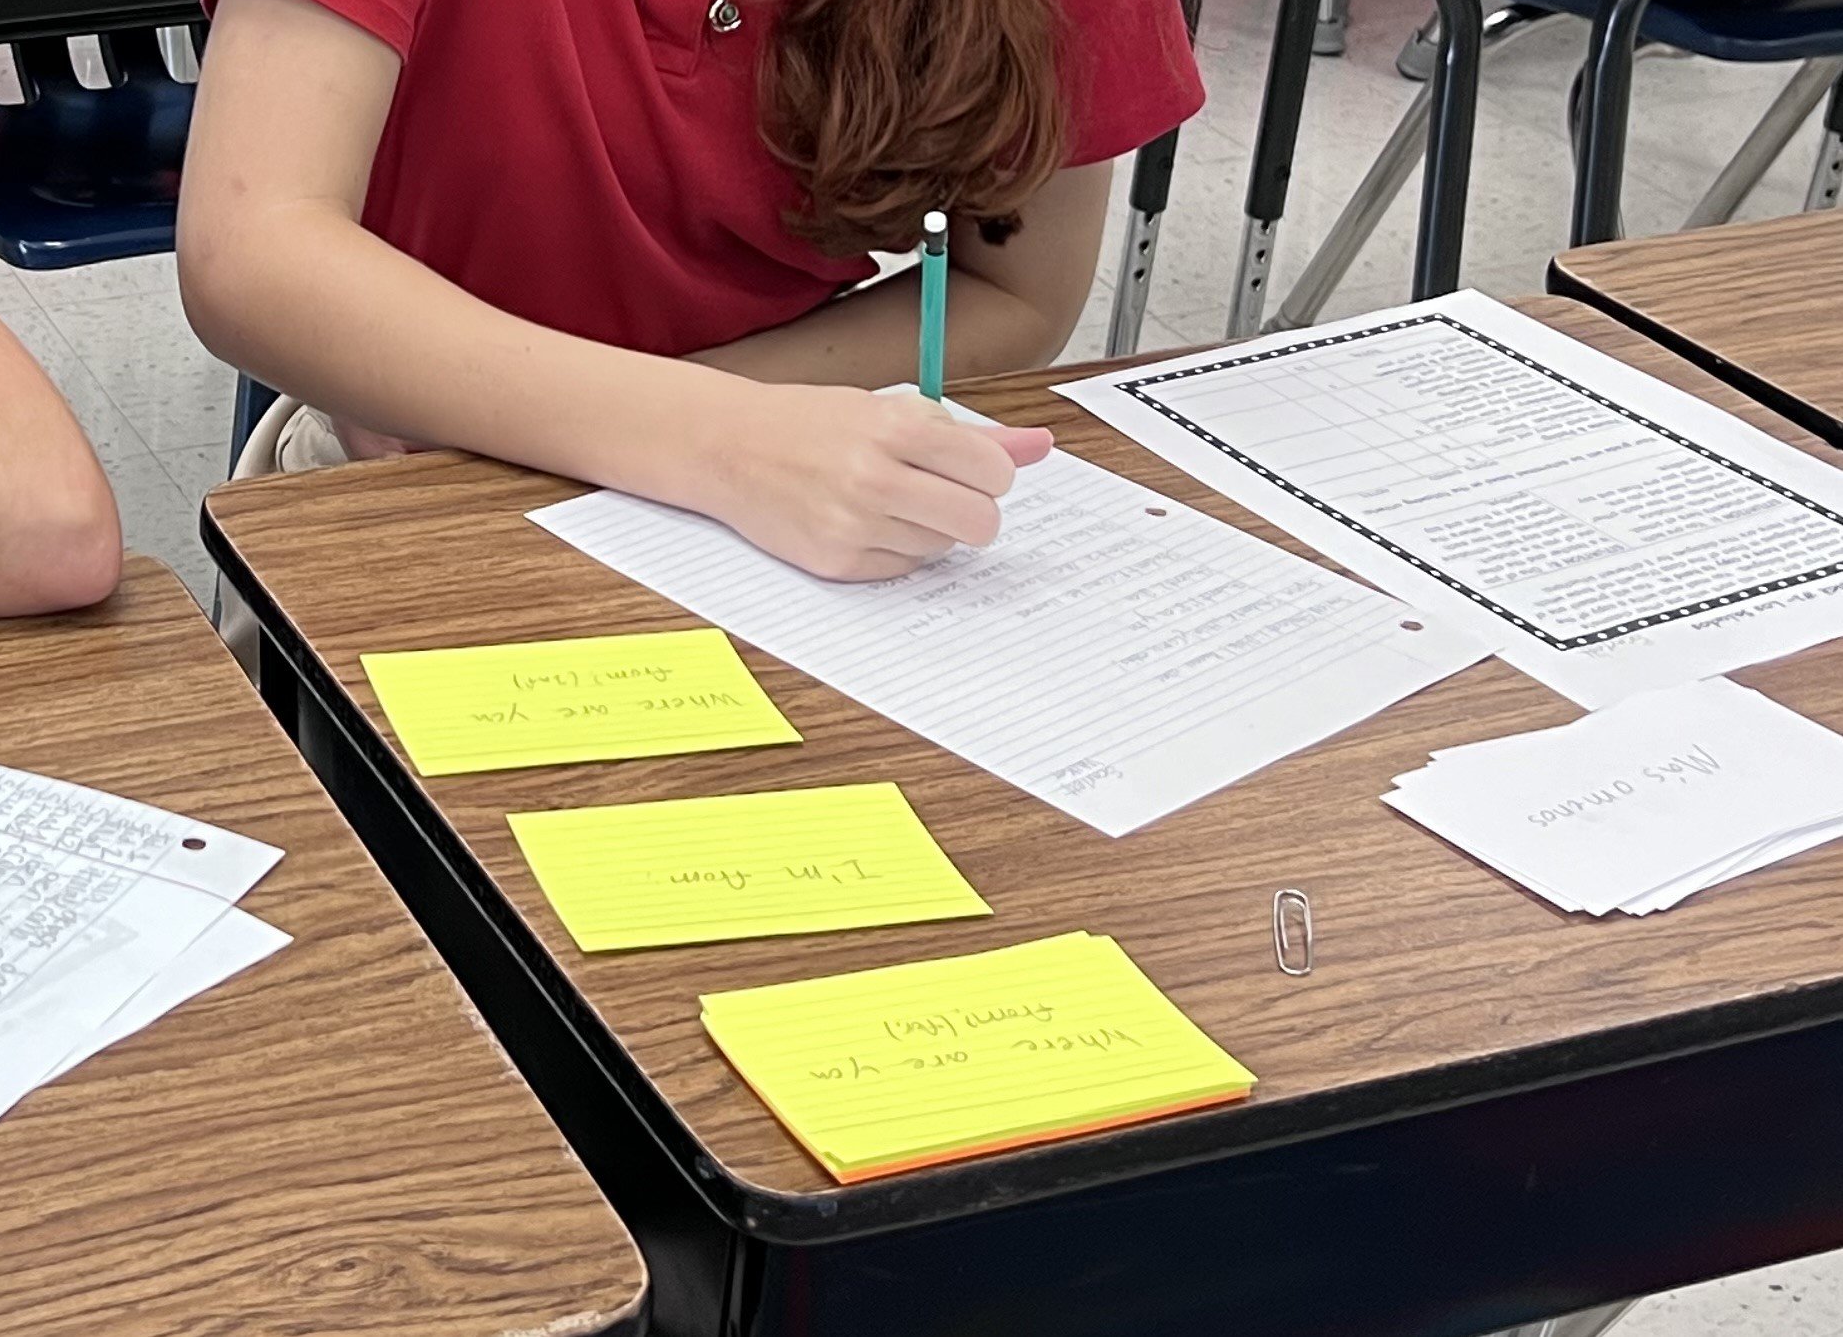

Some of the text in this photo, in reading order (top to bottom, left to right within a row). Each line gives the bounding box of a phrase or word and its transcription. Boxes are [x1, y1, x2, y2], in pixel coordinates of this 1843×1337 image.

[471, 693, 742, 723] Where are you
[810, 1029, 1144, 1080] Where are you
